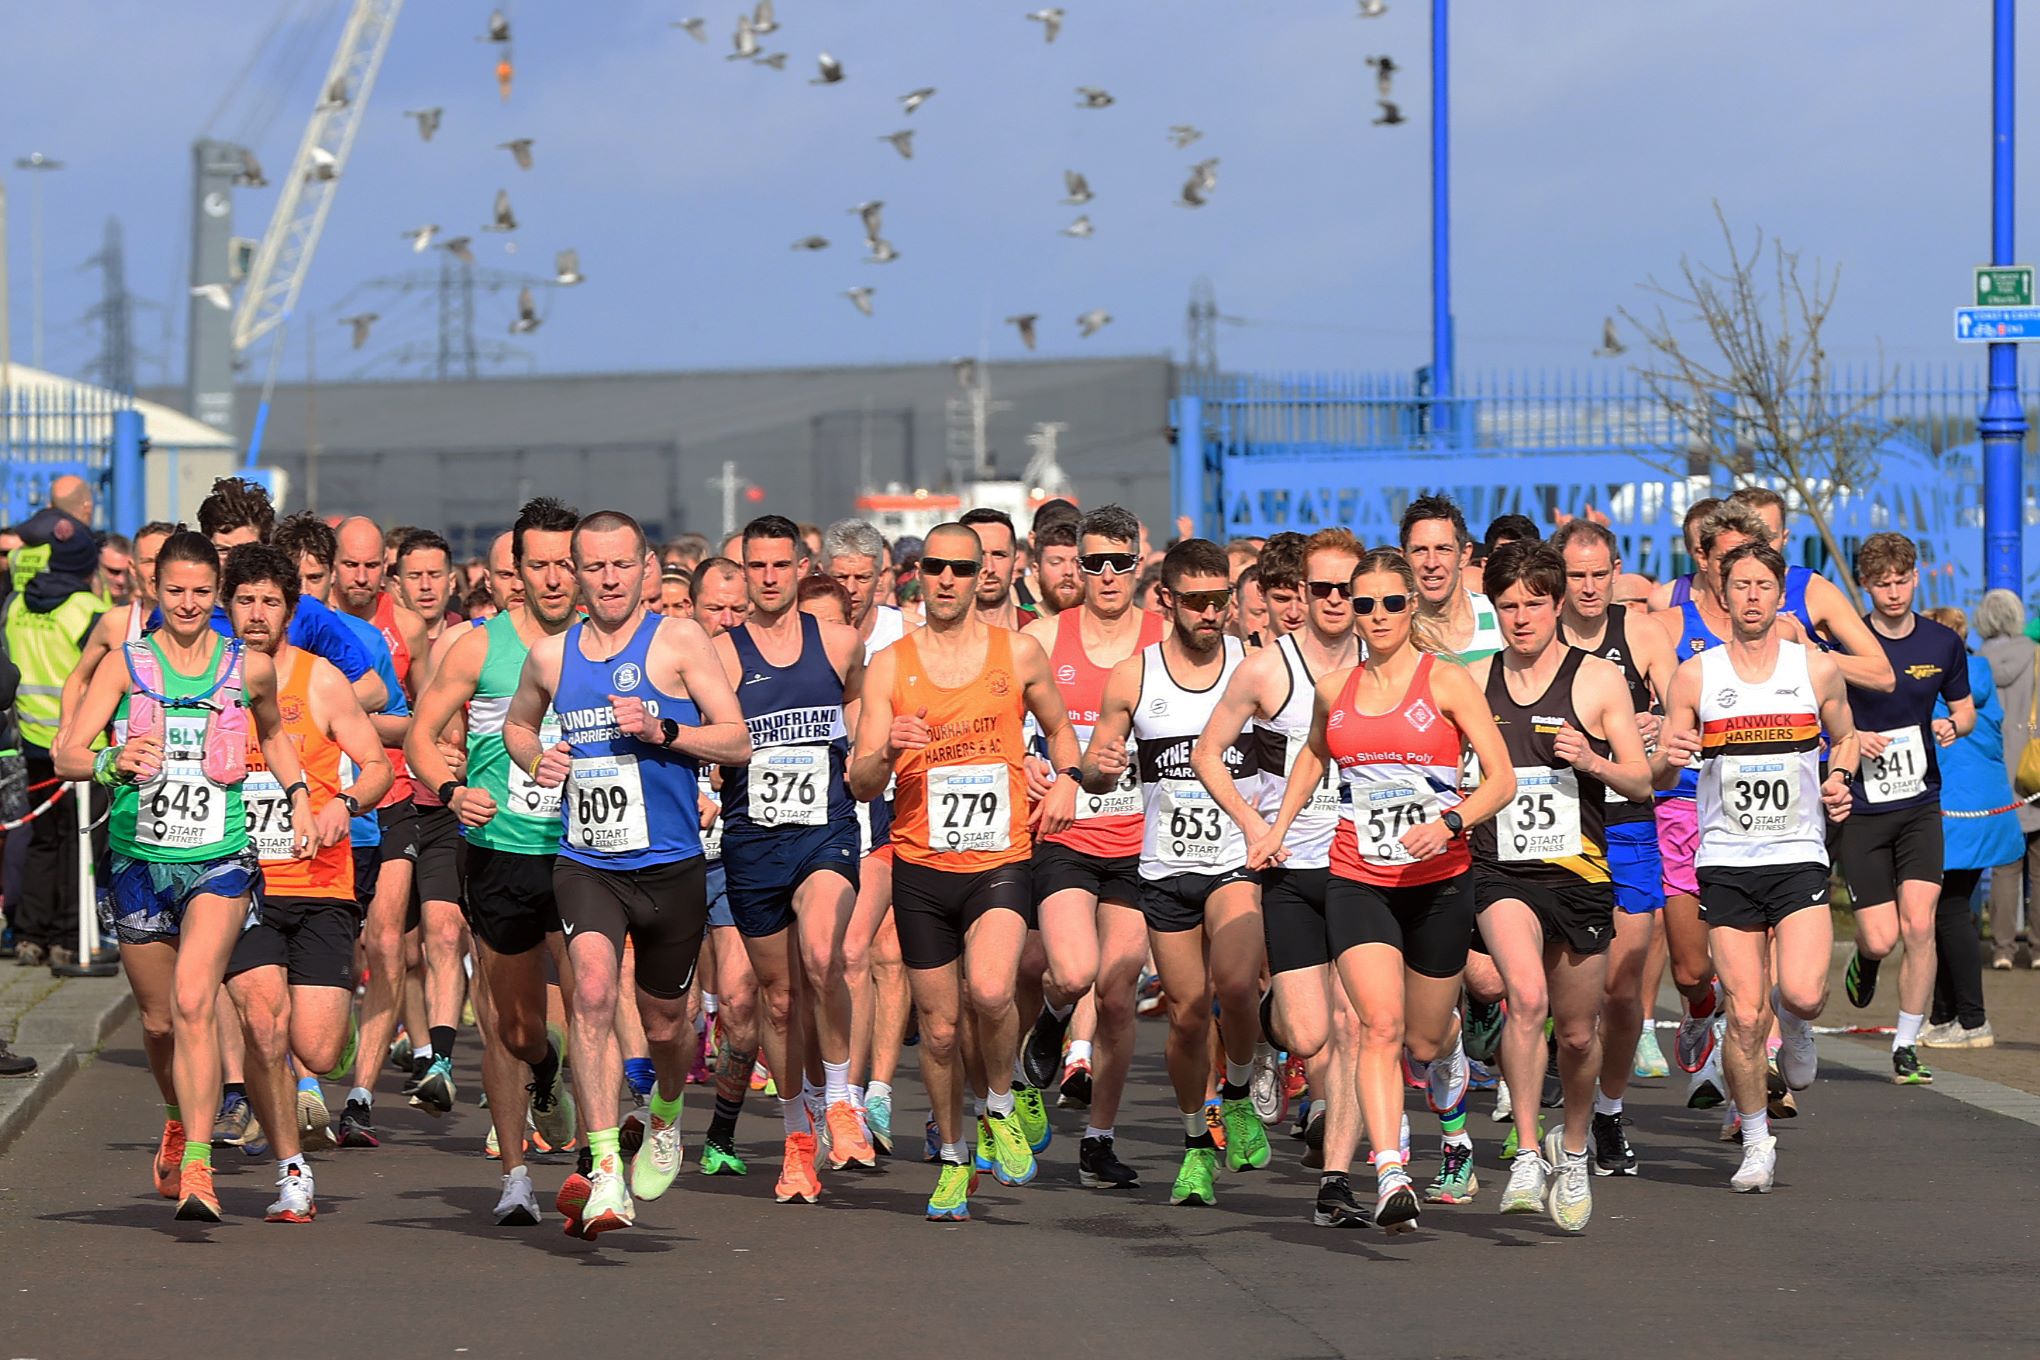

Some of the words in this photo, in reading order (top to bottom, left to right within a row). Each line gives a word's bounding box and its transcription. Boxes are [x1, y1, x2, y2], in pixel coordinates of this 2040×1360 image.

[559, 700, 659, 731] UNDERD
[1725, 713, 1792, 731] ALNWICK
[169, 727, 204, 746] BLY
[753, 723, 831, 746] STROLLERS
[928, 720, 971, 742] DURHAM
[973, 716, 998, 734] CITY
[1725, 728, 1794, 743] HARRIERS
[925, 741, 976, 764] HARRIERS
[1155, 741, 1189, 769] TYNE
[1338, 754, 1356, 766] rth
[1356, 751, 1403, 763] Shields
[1406, 752, 1434, 764] Poly
[1872, 749, 1915, 781] 341
[760, 771, 816, 805] 376
[1892, 779, 1918, 789] START
[151, 784, 210, 822] 643
[542, 796, 562, 805] STA
[1103, 796, 1135, 806] START
[1315, 796, 1342, 804] STAR
[1734, 779, 1790, 812] 390
[578, 785, 627, 825] 609
[942, 792, 997, 828] 279
[1103, 805, 1134, 813] FITNESS
[1517, 794, 1556, 831] 35
[245, 799, 293, 833] 673
[779, 809, 814, 819] START
[1754, 815, 1788, 825] START
[1170, 807, 1222, 841] 653
[1368, 803, 1426, 843] 570
[1753, 823, 1786, 831] FITNESS
[169, 826, 206, 837] START
[595, 828, 629, 839] START
[963, 831, 996, 842] START
[166, 835, 203, 845] FITNESS
[259, 838, 293, 848] START
[594, 838, 629, 847] FITNESS
[1530, 834, 1566, 845] START
[1186, 844, 1219, 853] START
[1528, 844, 1564, 853] FITNESS
